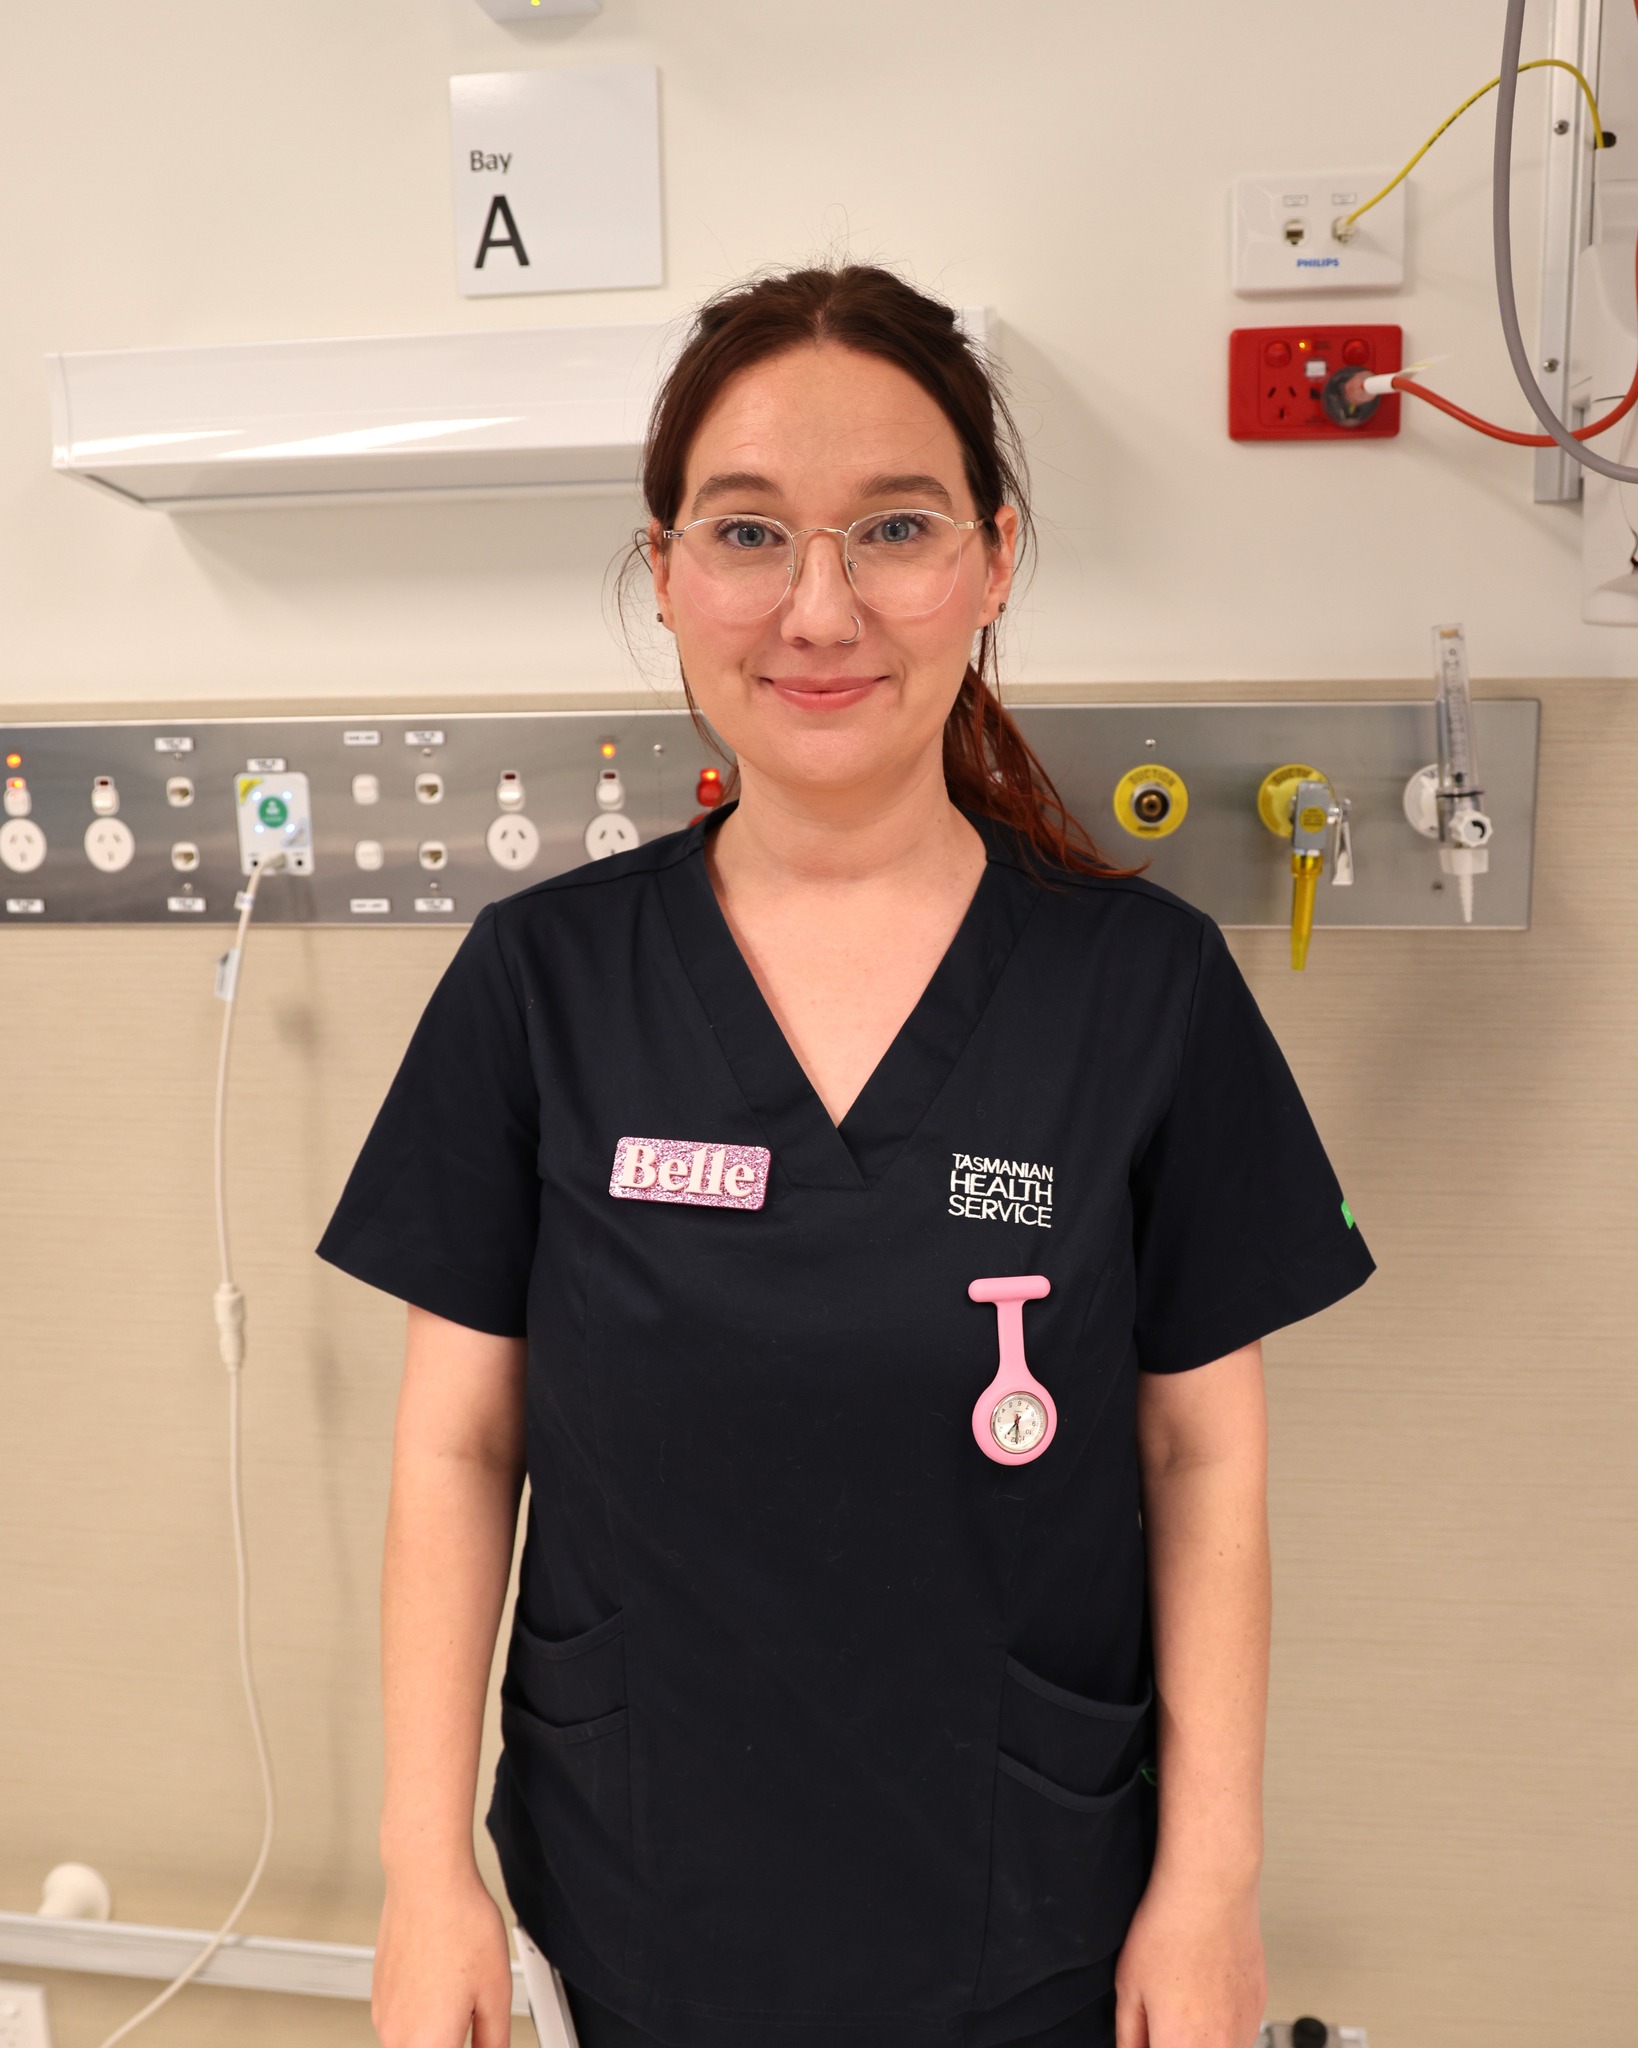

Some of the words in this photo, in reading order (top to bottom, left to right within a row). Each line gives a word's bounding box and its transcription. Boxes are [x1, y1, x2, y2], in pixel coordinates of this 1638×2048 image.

[470, 149, 512, 174] Bay
[474, 194, 530, 269] A
[1296, 258, 1340, 268] PHILIPS
[618, 1144, 755, 1198] Belle
[952, 1153, 1054, 1182] TASMANIAN
[950, 1170, 1053, 1205] HEALTH
[948, 1194, 1053, 1228] SERVICE
